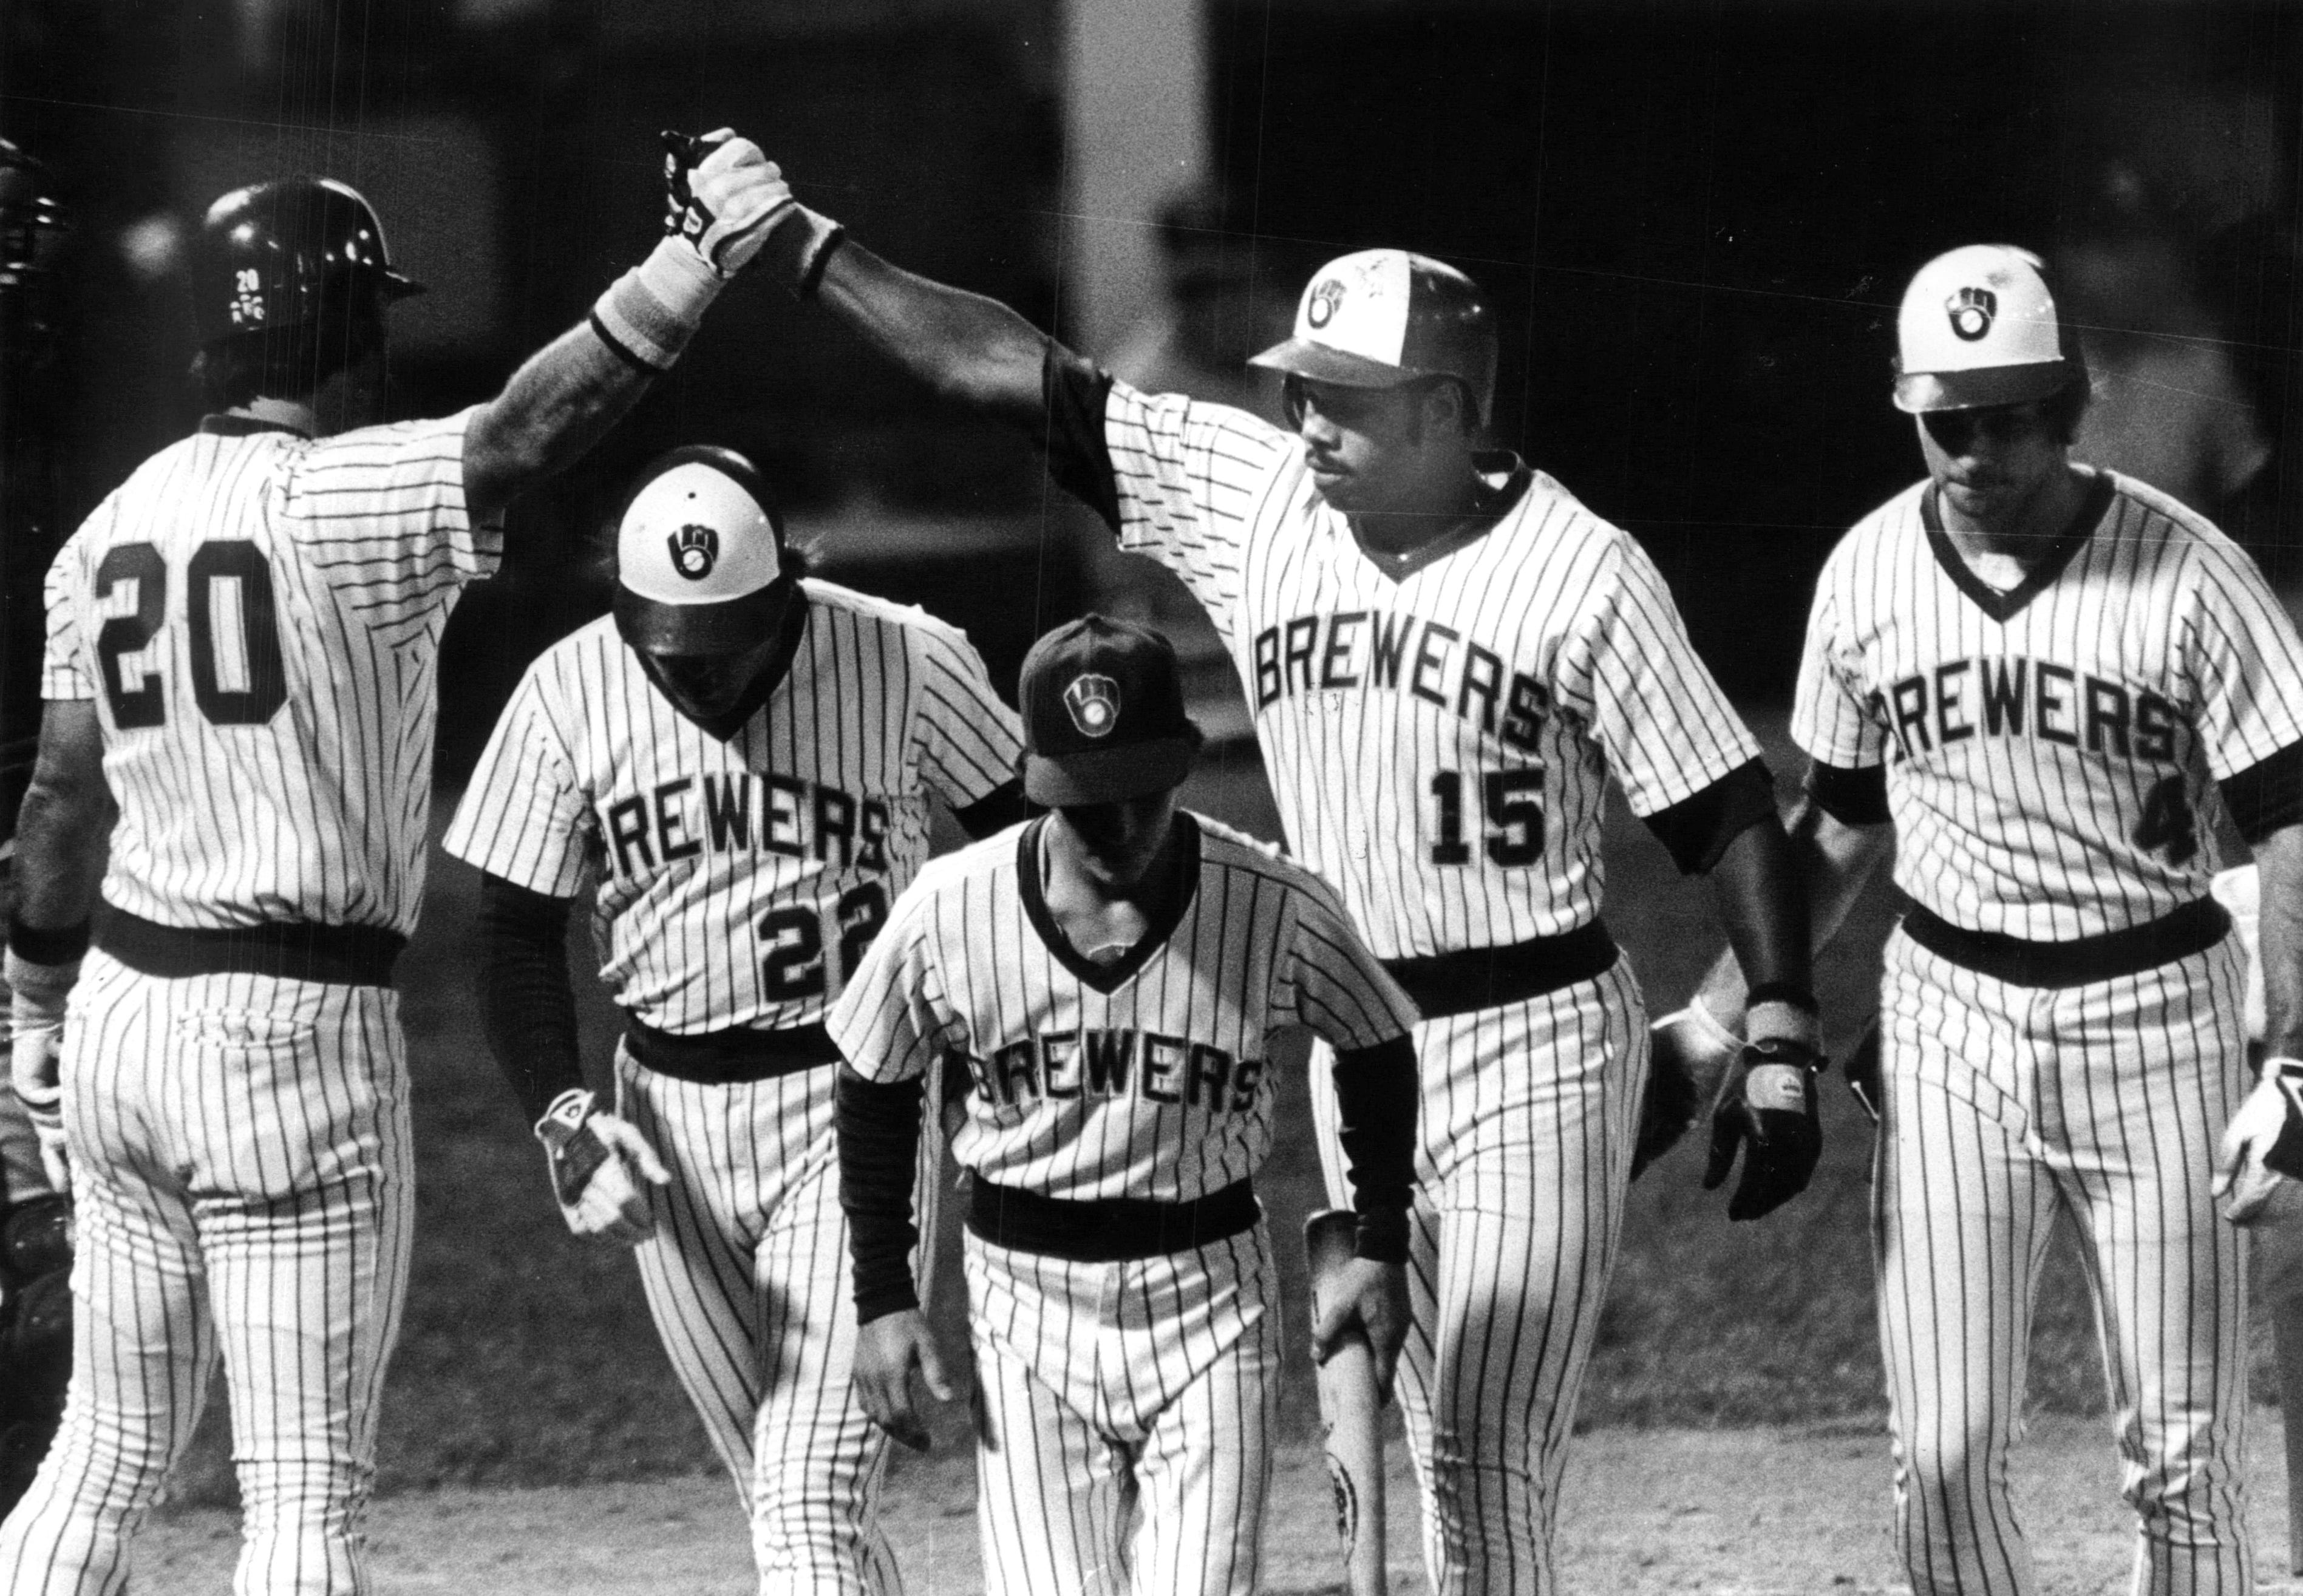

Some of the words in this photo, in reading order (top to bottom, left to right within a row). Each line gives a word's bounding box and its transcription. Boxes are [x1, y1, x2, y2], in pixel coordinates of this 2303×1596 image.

[236, 268, 260, 293] 20
[95, 540, 288, 729] 20
[1256, 610, 1550, 752] BREWERS
[599, 774, 888, 875] REWERS
[1431, 770, 1546, 867] 15
[2132, 775, 2199, 867] 4
